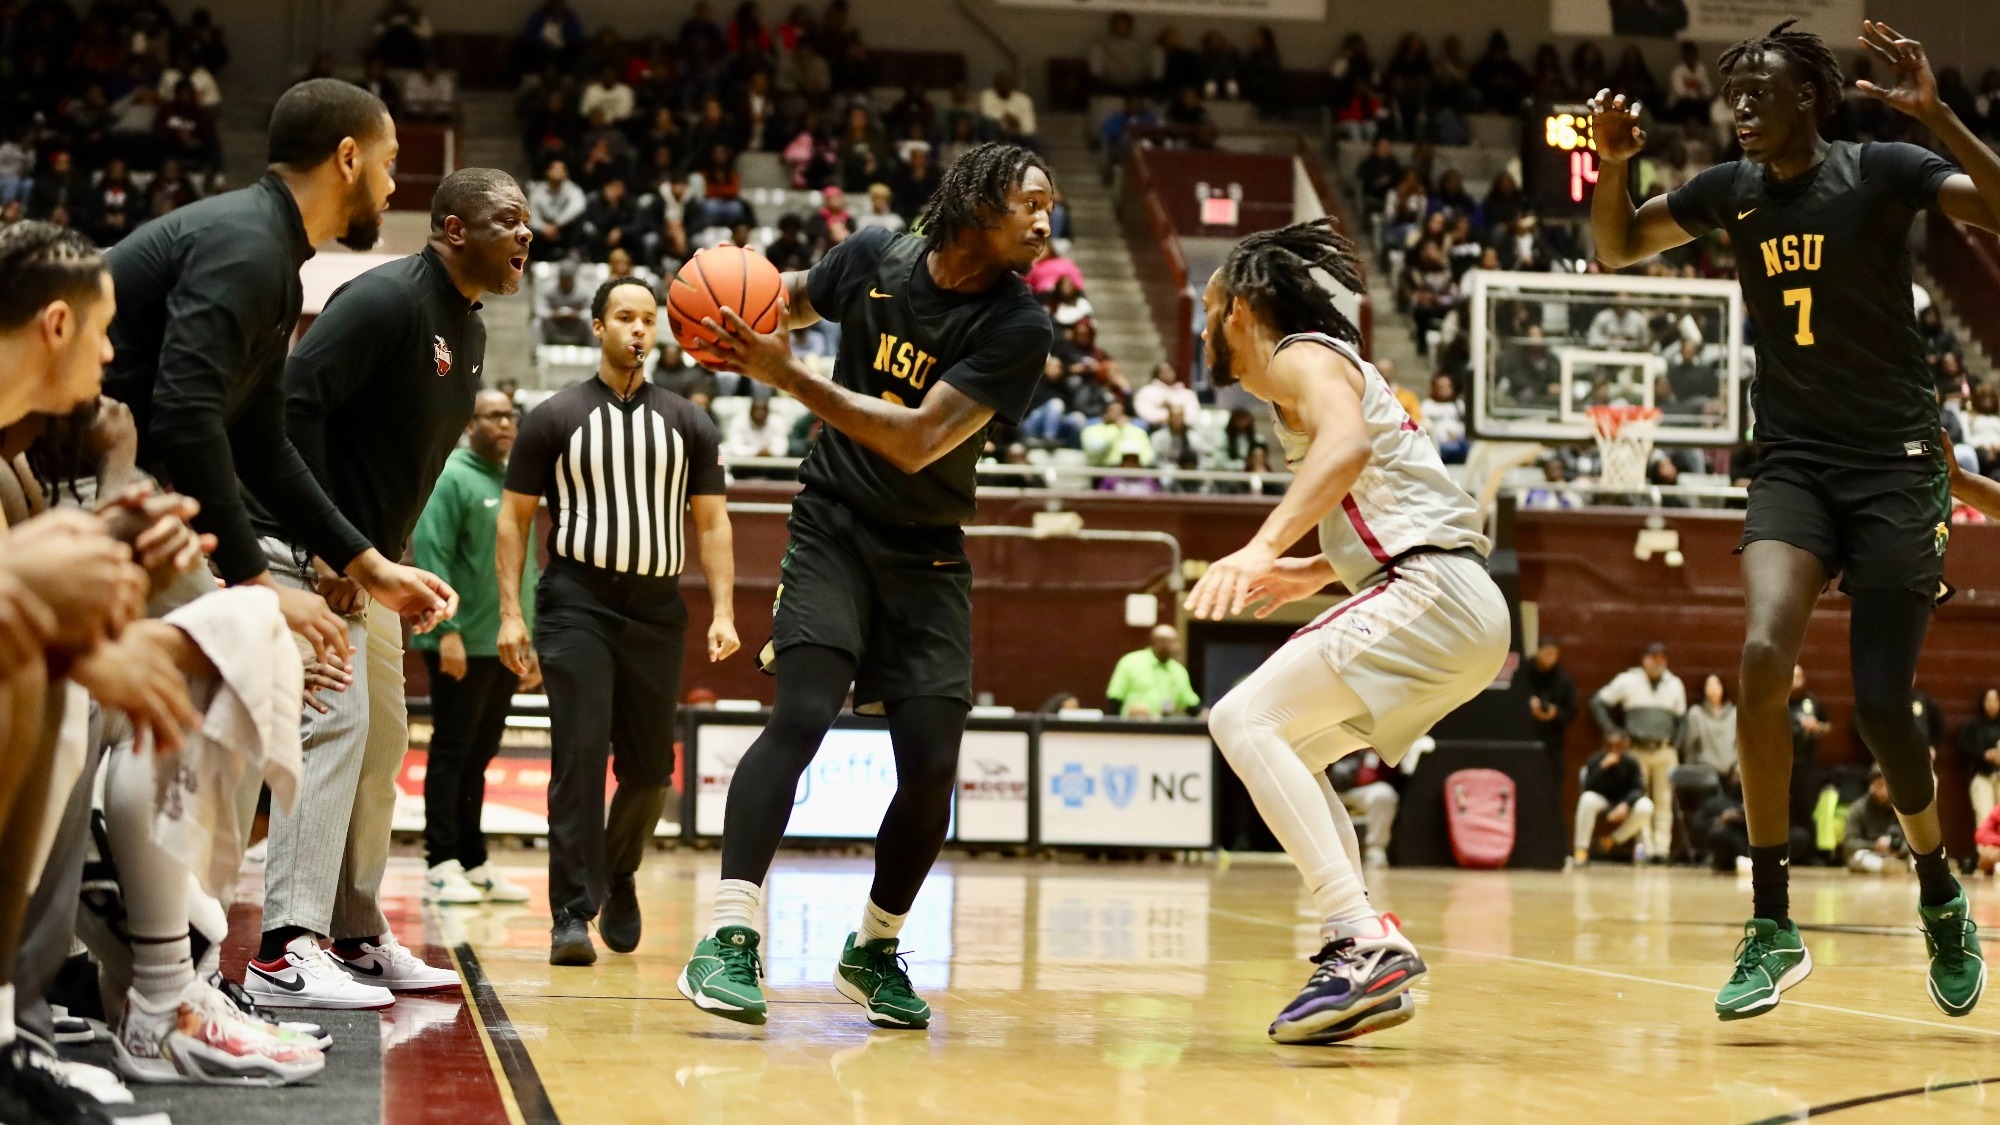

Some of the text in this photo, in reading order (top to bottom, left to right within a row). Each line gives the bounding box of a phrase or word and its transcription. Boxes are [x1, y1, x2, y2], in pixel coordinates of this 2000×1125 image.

[1546, 114, 1597, 150] 16:
[1760, 233, 1825, 278] NSU
[1783, 287, 1815, 346] 7
[873, 332, 938, 390] NSU
[1151, 772, 1201, 803] NC
